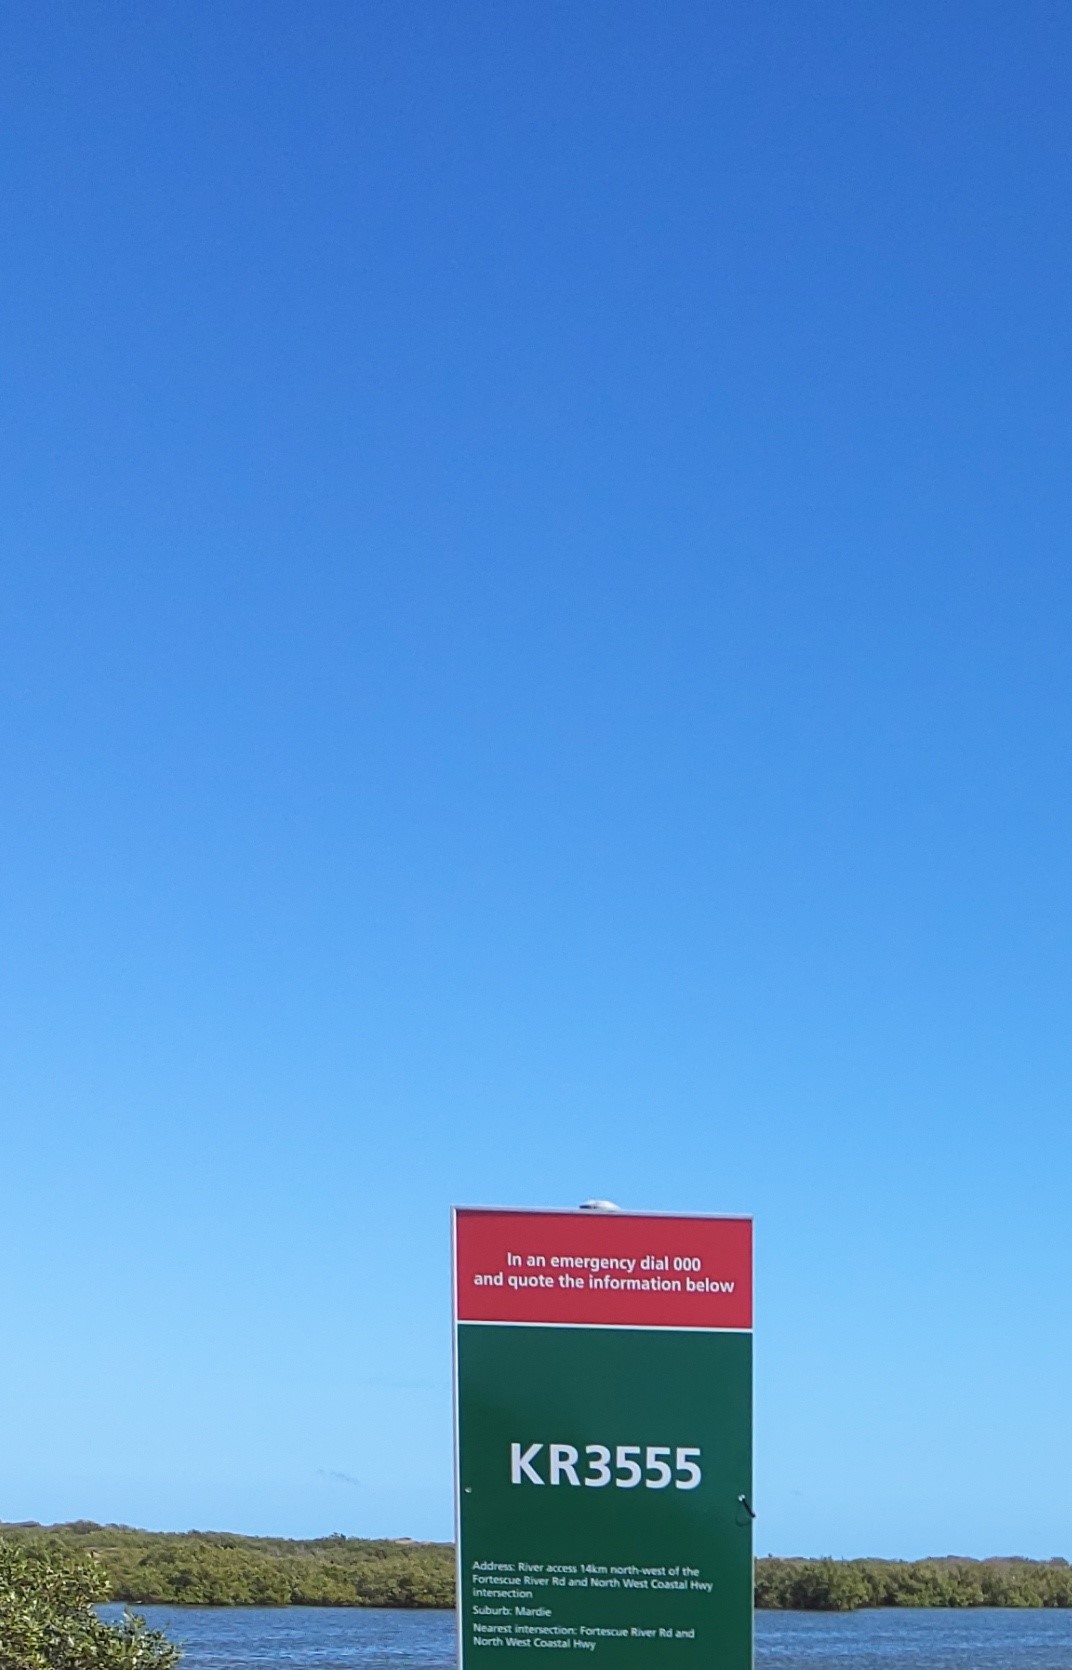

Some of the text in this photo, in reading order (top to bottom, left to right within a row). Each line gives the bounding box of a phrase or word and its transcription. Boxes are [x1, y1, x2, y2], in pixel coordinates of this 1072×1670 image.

[507, 1252, 702, 1272] In an emergency dial 000
[474, 1273, 735, 1293] and quote the information below
[511, 1443, 702, 1490] KR3555
[472, 1561, 700, 1577] Address: River access 14km north-west of the
[472, 1574, 713, 1593] Fortescue River Rd and North West Coastal Hwy
[472, 1587, 533, 1598] intersection
[472, 1605, 552, 1617] Suburb: Mardie
[473, 1623, 695, 1638] Nearest intersection: Fortescue River Rd and
[473, 1637, 597, 1651] North West Coastal Hwy
